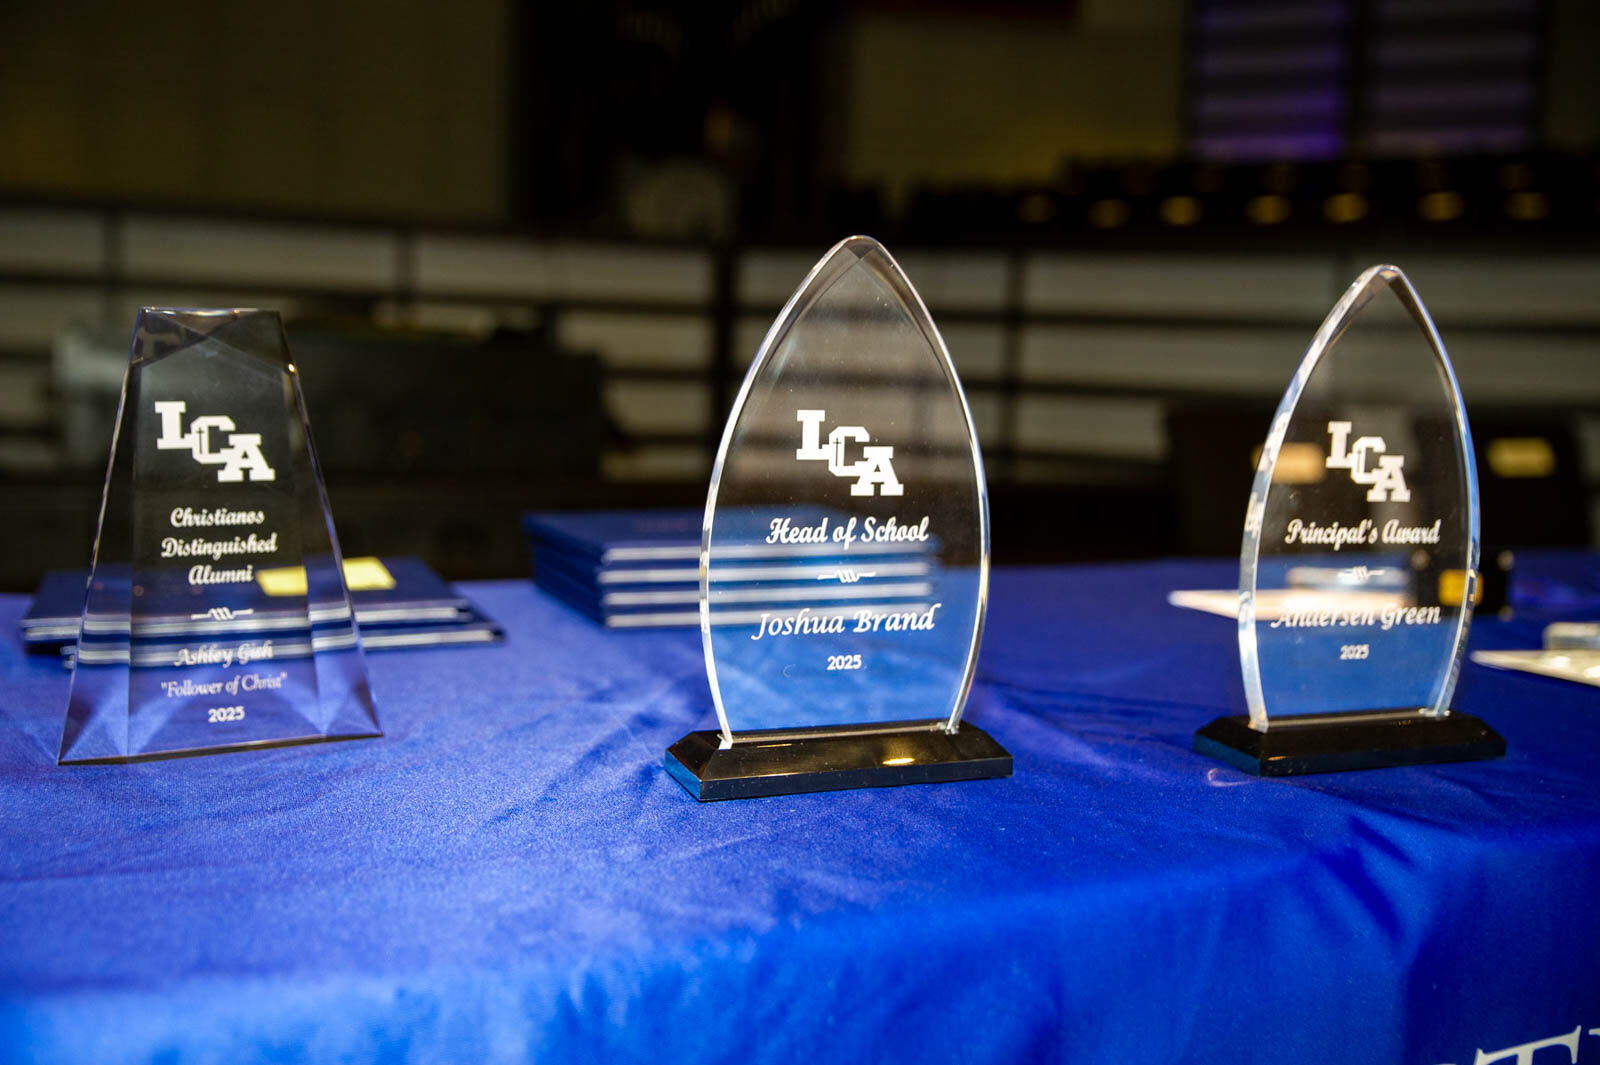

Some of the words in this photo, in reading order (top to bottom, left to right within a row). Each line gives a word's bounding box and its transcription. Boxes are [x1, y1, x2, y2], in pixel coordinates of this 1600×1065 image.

[154, 400, 276, 483] LCA
[796, 409, 905, 497] LCA
[1326, 421, 1412, 502] LCA
[170, 506, 266, 528] Christianos
[160, 531, 279, 561] Distinguished
[765, 516, 828, 545] Head
[831, 516, 858, 550] of
[860, 515, 930, 543] School
[1284, 518, 1378, 552] Principal's
[1381, 518, 1442, 545] Award
[188, 563, 254, 585] Alumni
[750, 607, 846, 641] Joshua
[852, 602, 942, 634] Brand
[1380, 605, 1442, 631] Green
[173, 642, 234, 668] Ashley
[826, 654, 863, 671] 2025
[1339, 643, 1370, 661] 2025
[160, 678, 223, 698] "Follower
[224, 675, 241, 697] of
[241, 671, 288, 692] Christ"
[207, 705, 246, 723] 2025
